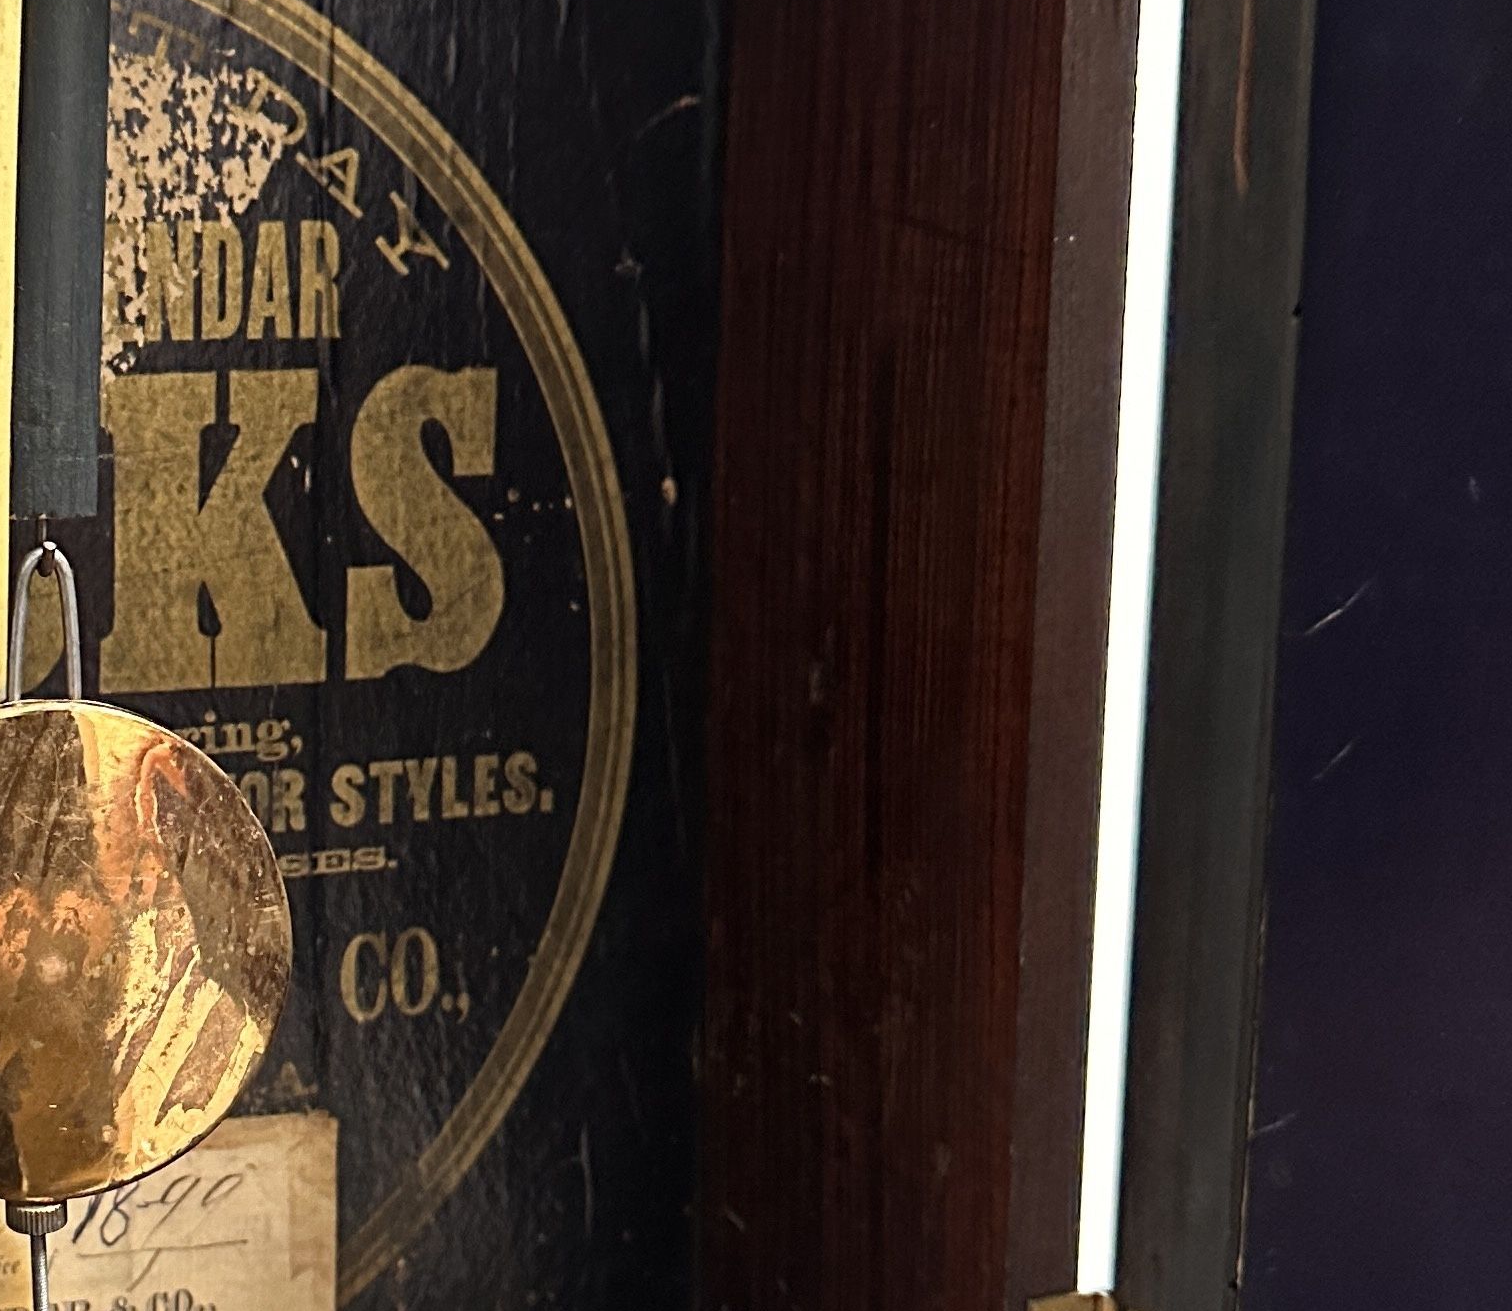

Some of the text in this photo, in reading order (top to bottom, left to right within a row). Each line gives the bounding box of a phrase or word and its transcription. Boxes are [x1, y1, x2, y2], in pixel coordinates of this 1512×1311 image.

[103, 219, 342, 344] ENDAR
[329, 750, 555, 829] STYLES.
[339, 926, 471, 1025] CO.,
